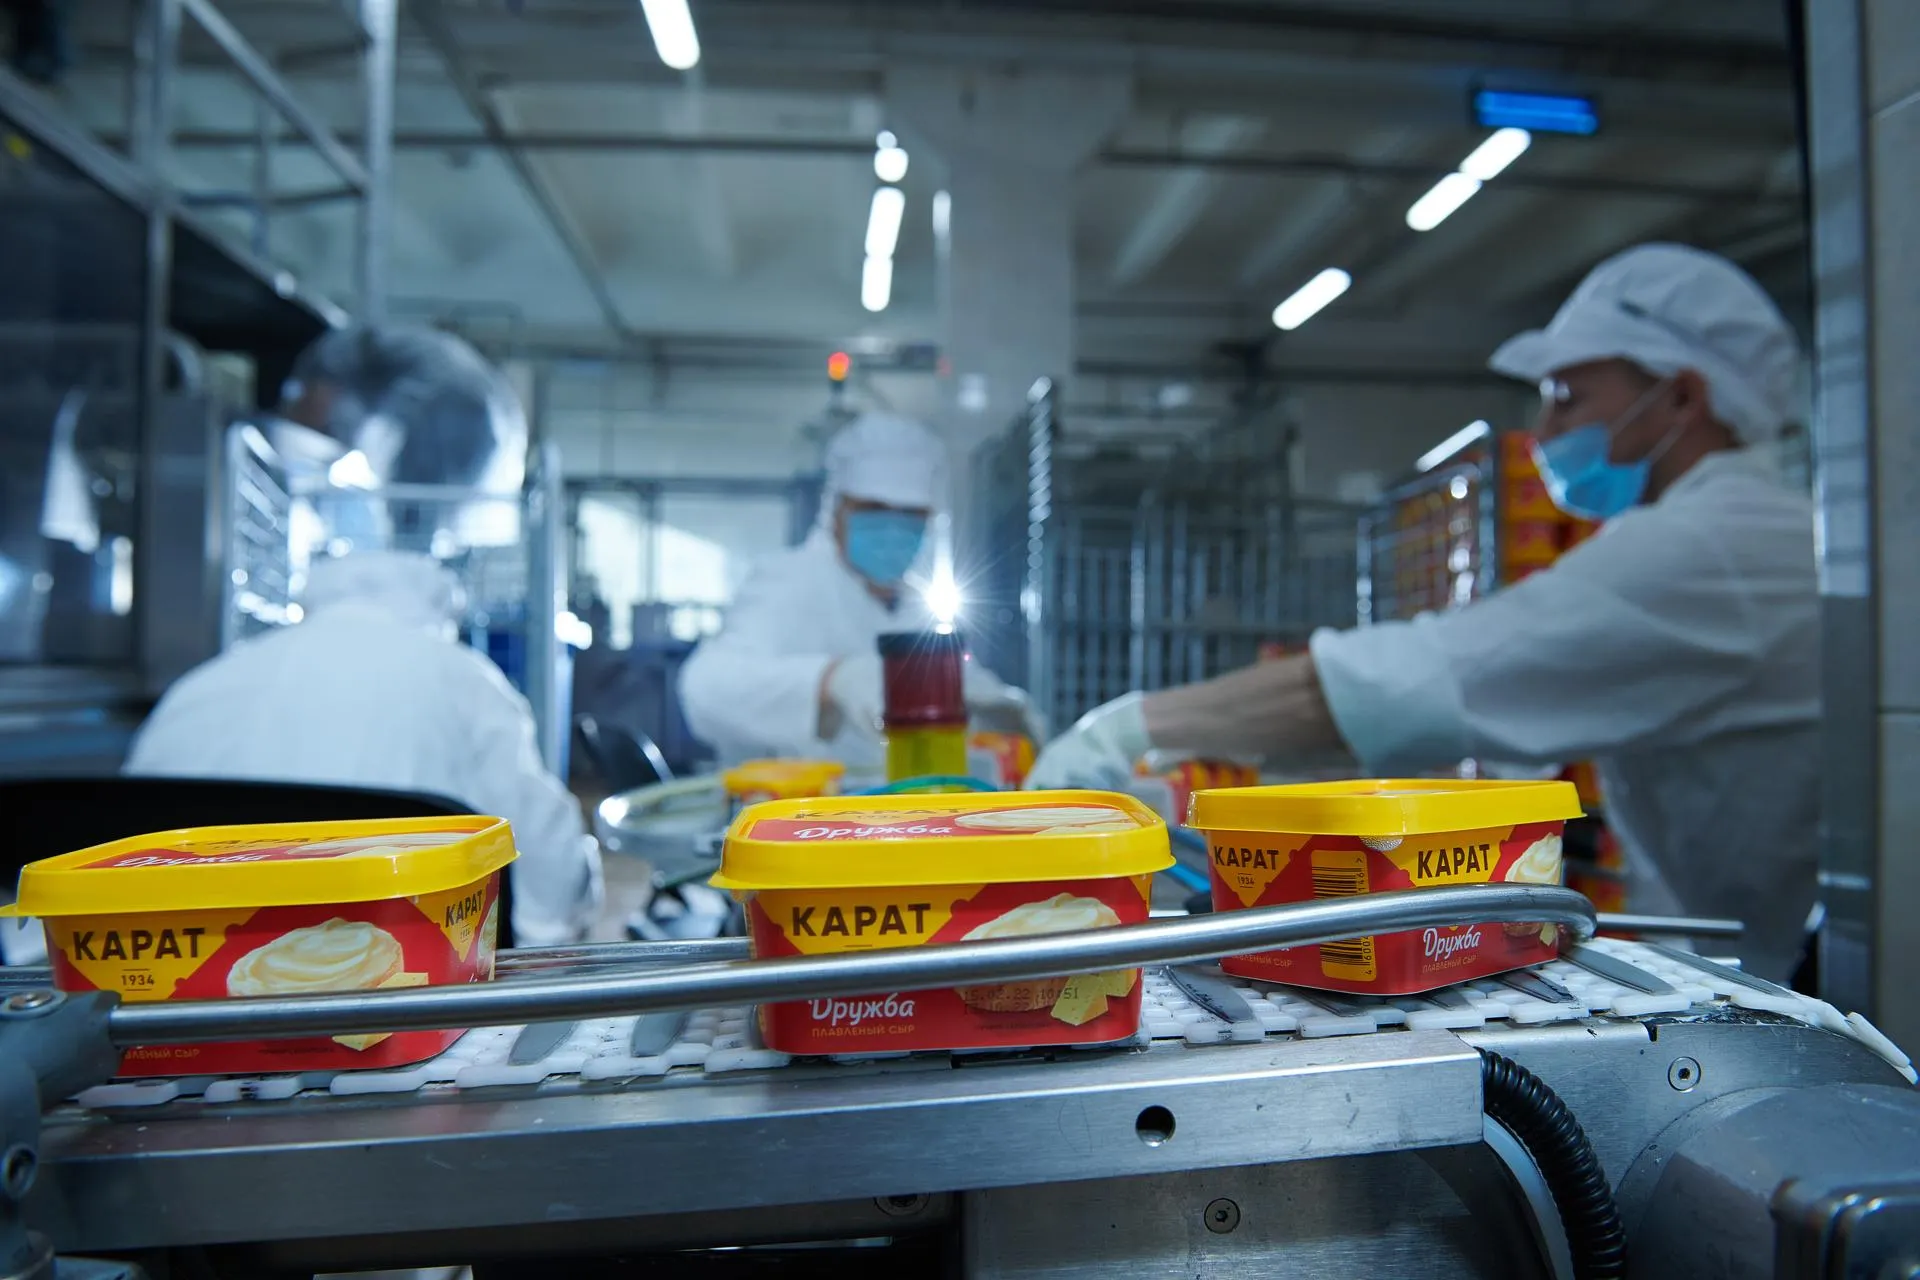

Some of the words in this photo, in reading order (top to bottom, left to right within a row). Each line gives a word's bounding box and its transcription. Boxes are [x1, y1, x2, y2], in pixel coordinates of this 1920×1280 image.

[793, 825, 953, 840] Дружба
[1214, 846, 1279, 870] КАРАТ
[1417, 844, 1490, 879] КАРАТ
[1237, 875, 1255, 885] 1934
[445, 889, 483, 928] КАРАТ
[792, 903, 931, 937] КАРАТ
[73, 928, 205, 960] КАРАТ
[1423, 925, 1481, 962] Дружба
[122, 974, 154, 986] 1934
[808, 992, 915, 1027] Дружба
[812, 1026, 885, 1038] ПЛАВЛЕНЫЙ
[888, 1024, 915, 1034] СЫР
[175, 1048, 200, 1059] СЫР
